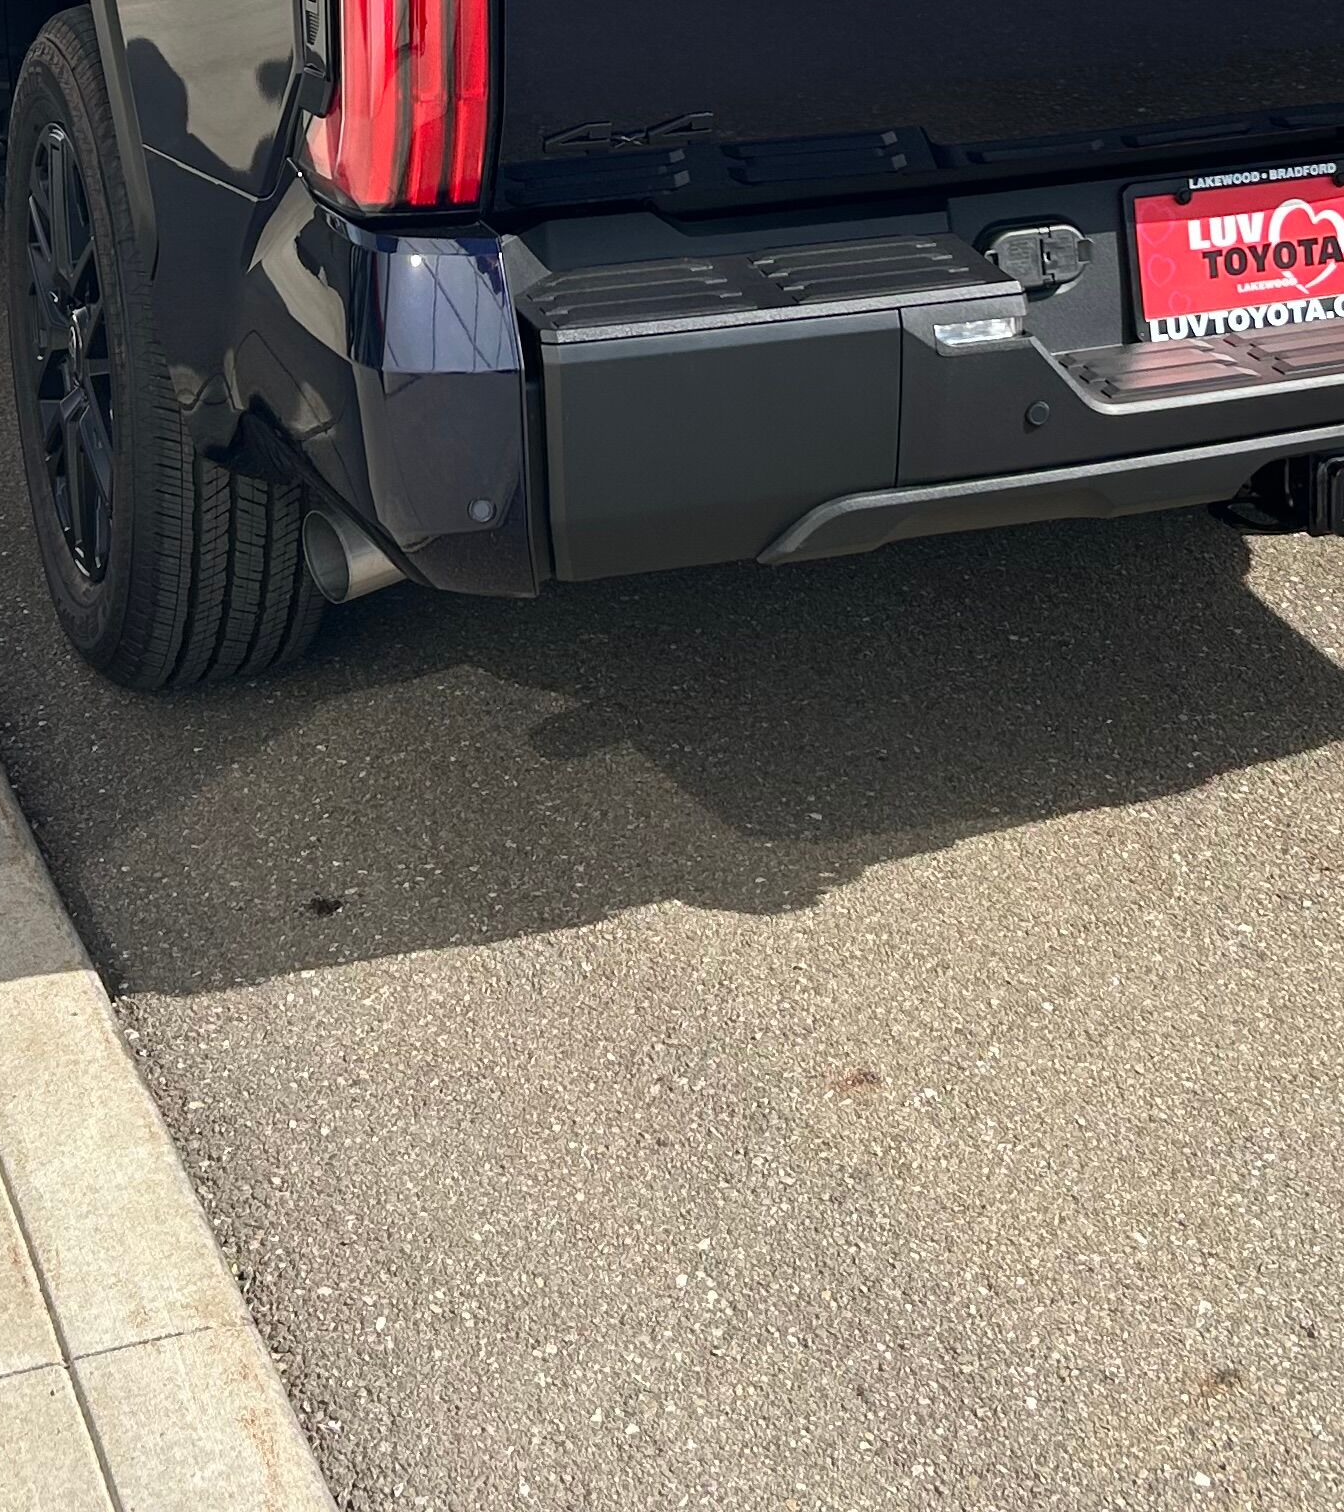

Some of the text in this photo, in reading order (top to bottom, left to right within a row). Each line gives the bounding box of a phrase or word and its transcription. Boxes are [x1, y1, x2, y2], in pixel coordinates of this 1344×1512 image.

[1188, 162, 1337, 190] LAKEWOOD BRADFORD
[1187, 211, 1265, 250] LUV
[1203, 235, 1344, 279] TOYOTA
